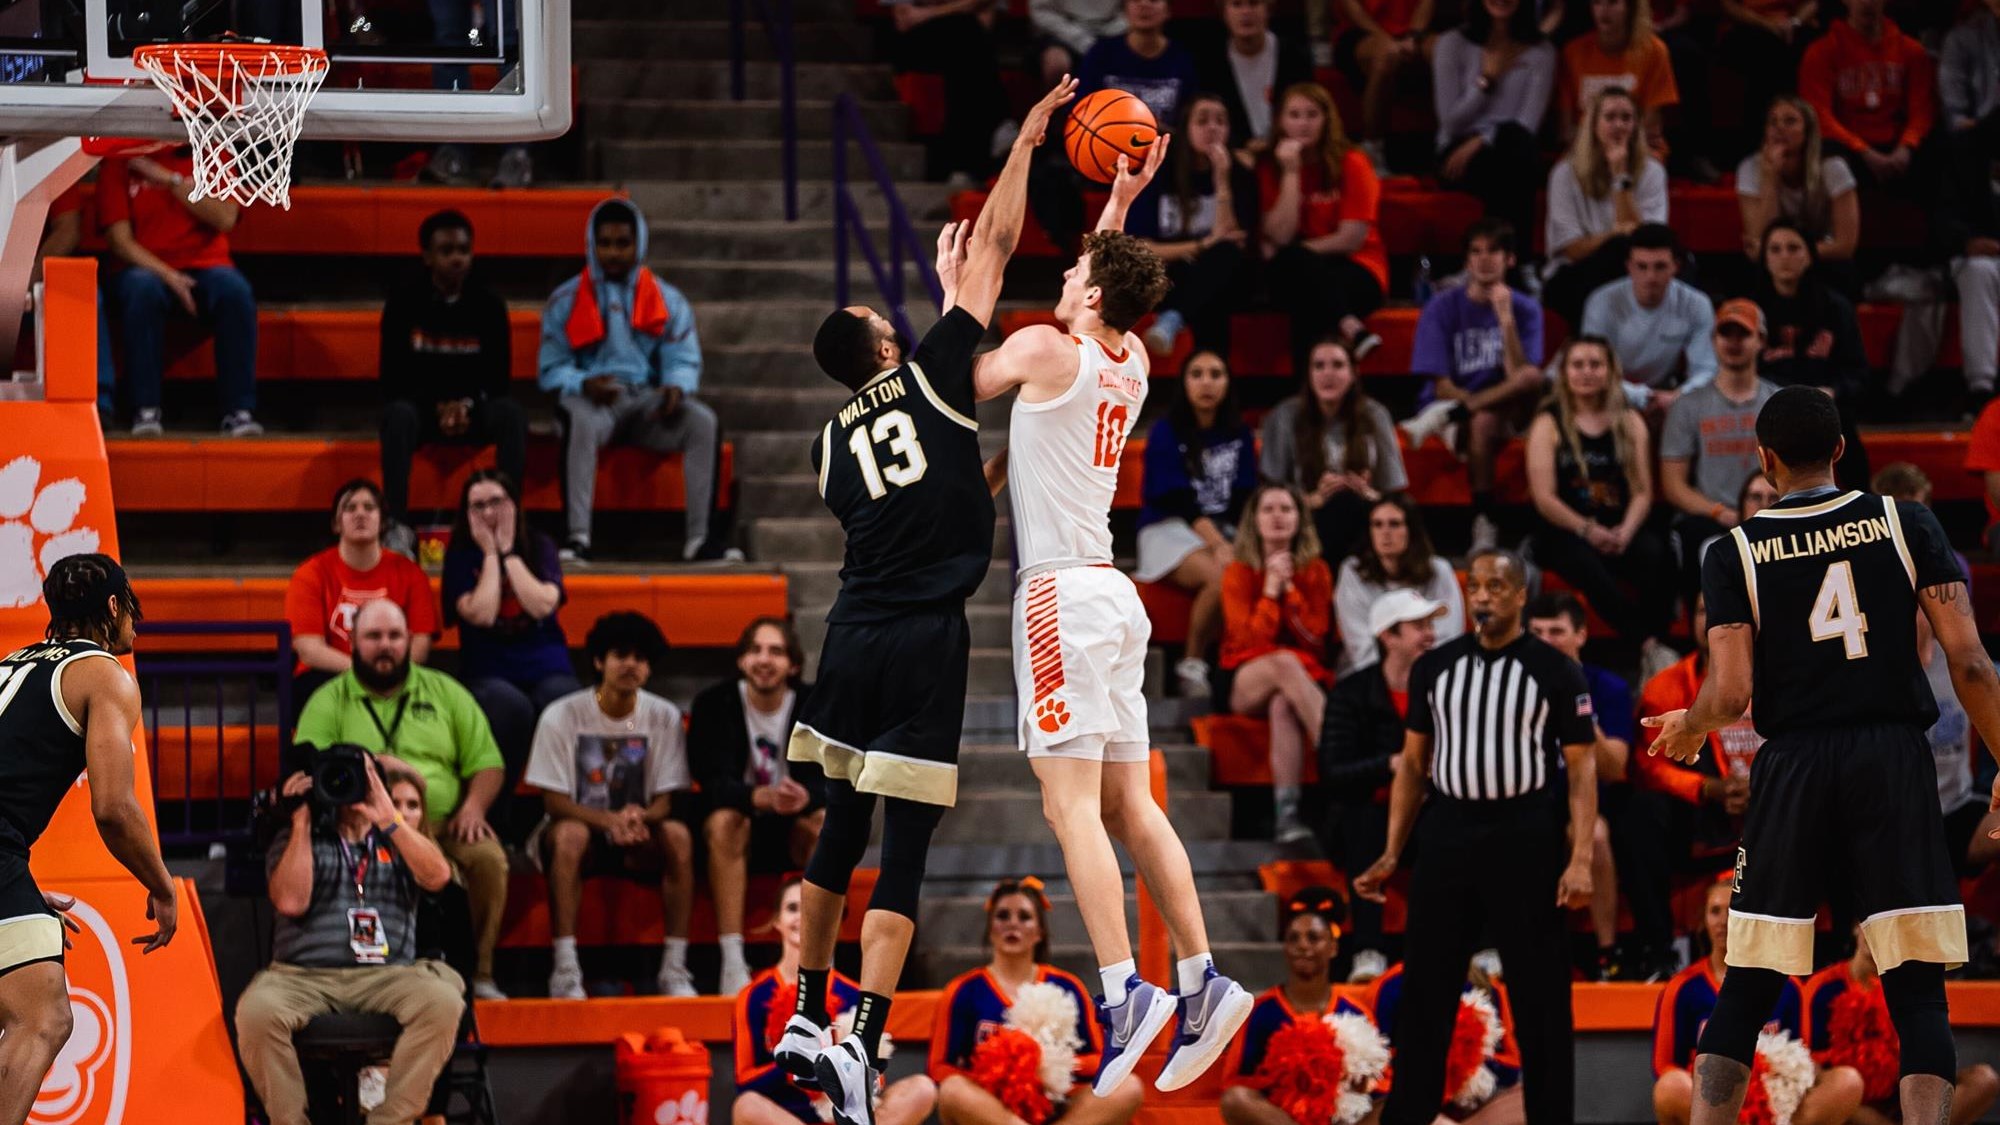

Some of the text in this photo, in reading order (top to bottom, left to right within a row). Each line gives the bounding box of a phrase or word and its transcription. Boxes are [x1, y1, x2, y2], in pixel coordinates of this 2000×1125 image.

[838, 376, 907, 429] WALTON
[1093, 400, 1129, 468] 10
[848, 408, 929, 500] 13
[1750, 516, 1892, 565] WILLIAMSON
[1808, 560, 1869, 660] 4
